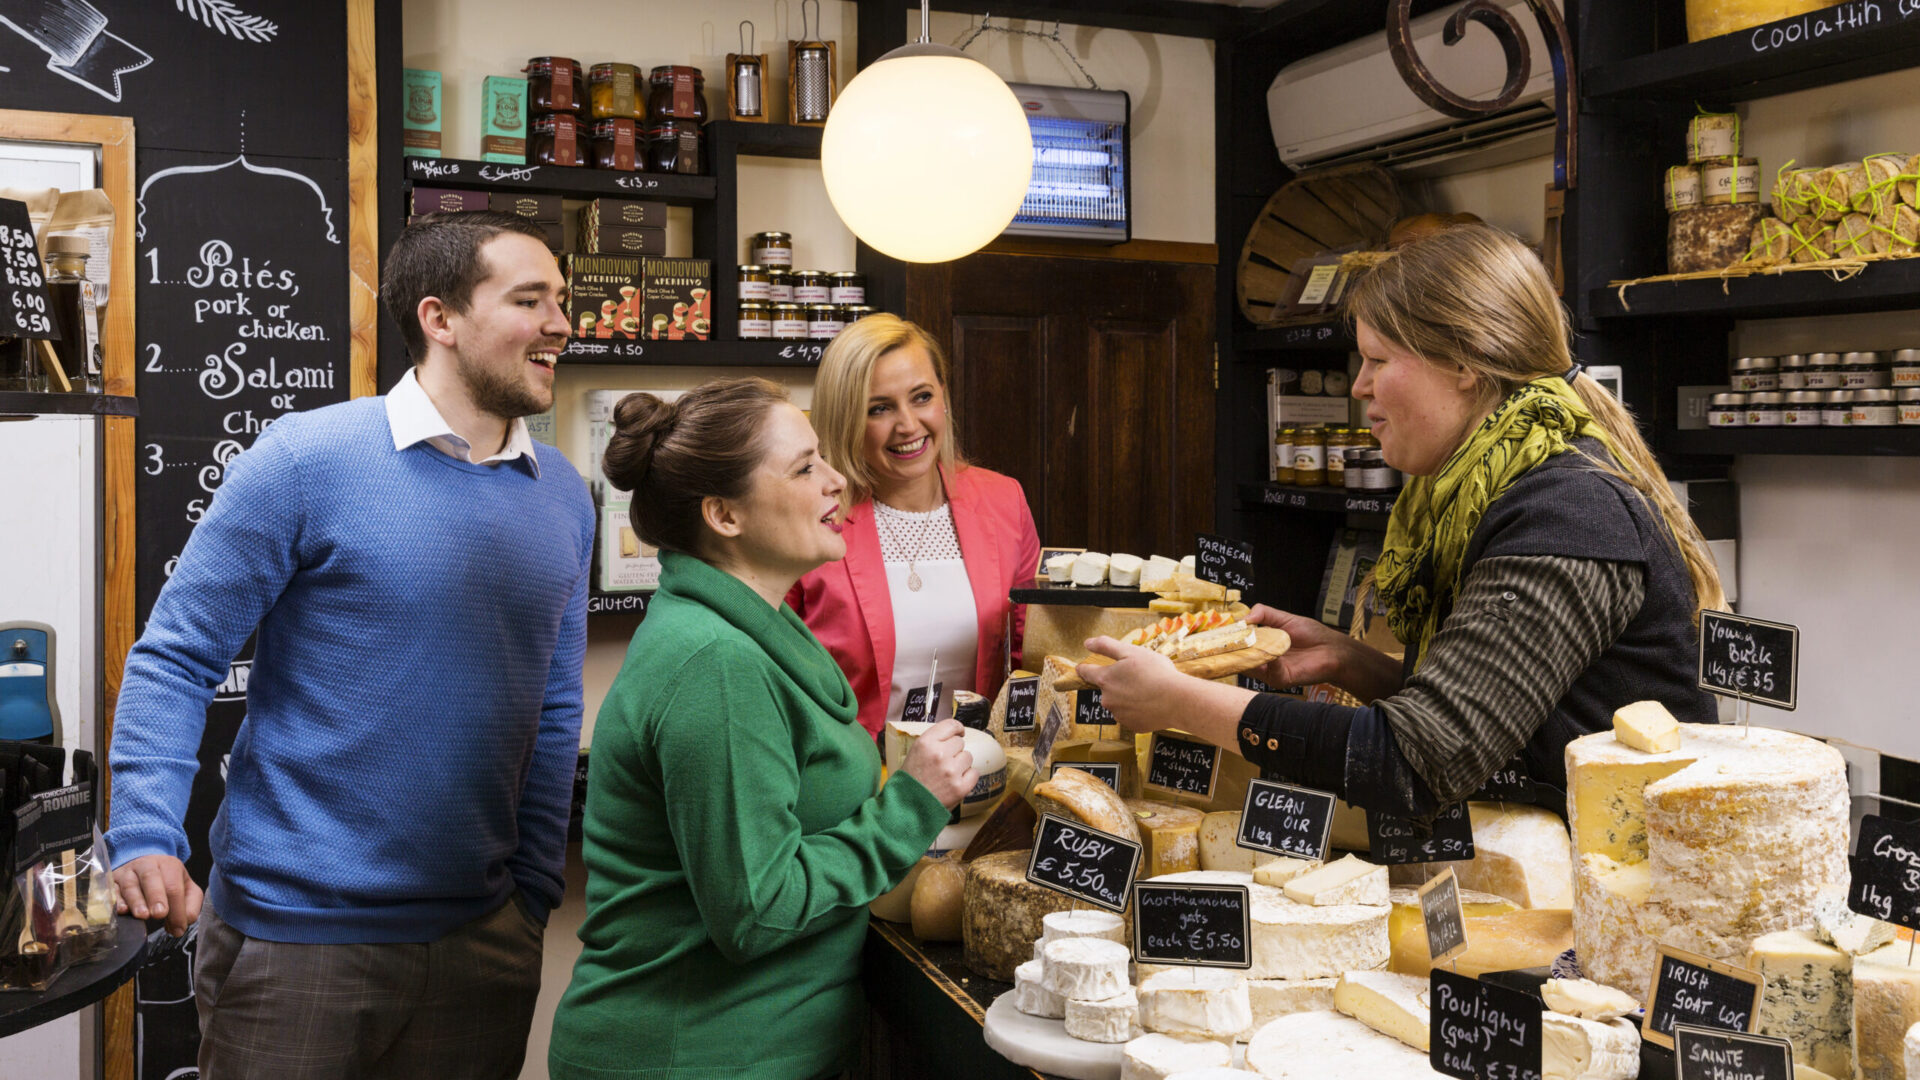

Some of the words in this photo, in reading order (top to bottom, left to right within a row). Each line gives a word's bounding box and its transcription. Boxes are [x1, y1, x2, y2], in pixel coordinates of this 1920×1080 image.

[1751, 0, 1881, 52] Coolattin
[425, 164, 460, 179] PRICE
[575, 257, 639, 276] MONDOVINO
[646, 261, 709, 278] MONDOVINO
[582, 275, 631, 284] APERITIVO
[654, 277, 702, 286] APERITIVO
[194, 292, 252, 323] pork
[267, 304, 290, 319] or
[238, 319, 331, 341] chicken.
[613, 343, 644, 356] 4.50
[797, 343, 824, 361] 4,9
[199, 342, 334, 400] Salami
[270, 394, 296, 409] or
[1198, 537, 1252, 564] PARMESAN
[587, 595, 644, 612] Gluten
[1709, 619, 1756, 655] Young
[1728, 642, 1772, 665] Buck
[42, 790, 91, 813] ROWNIE
[1255, 791, 1305, 815] GLEAN
[1283, 815, 1310, 832] OIR
[1053, 827, 1115, 861] RUBY
[1036, 857, 1058, 871] €
[1147, 932, 1183, 947] each
[1188, 929, 1204, 950] €
[1206, 932, 1241, 949] 5.50
[1667, 963, 1709, 990] IRISH
[1437, 983, 1526, 1047] Pouligny
[1672, 989, 1713, 1014] GOAT
[1718, 1005, 1746, 1032] LOG
[1440, 1018, 1491, 1052] (goat)
[1688, 1042, 1744, 1068] SAINTE
